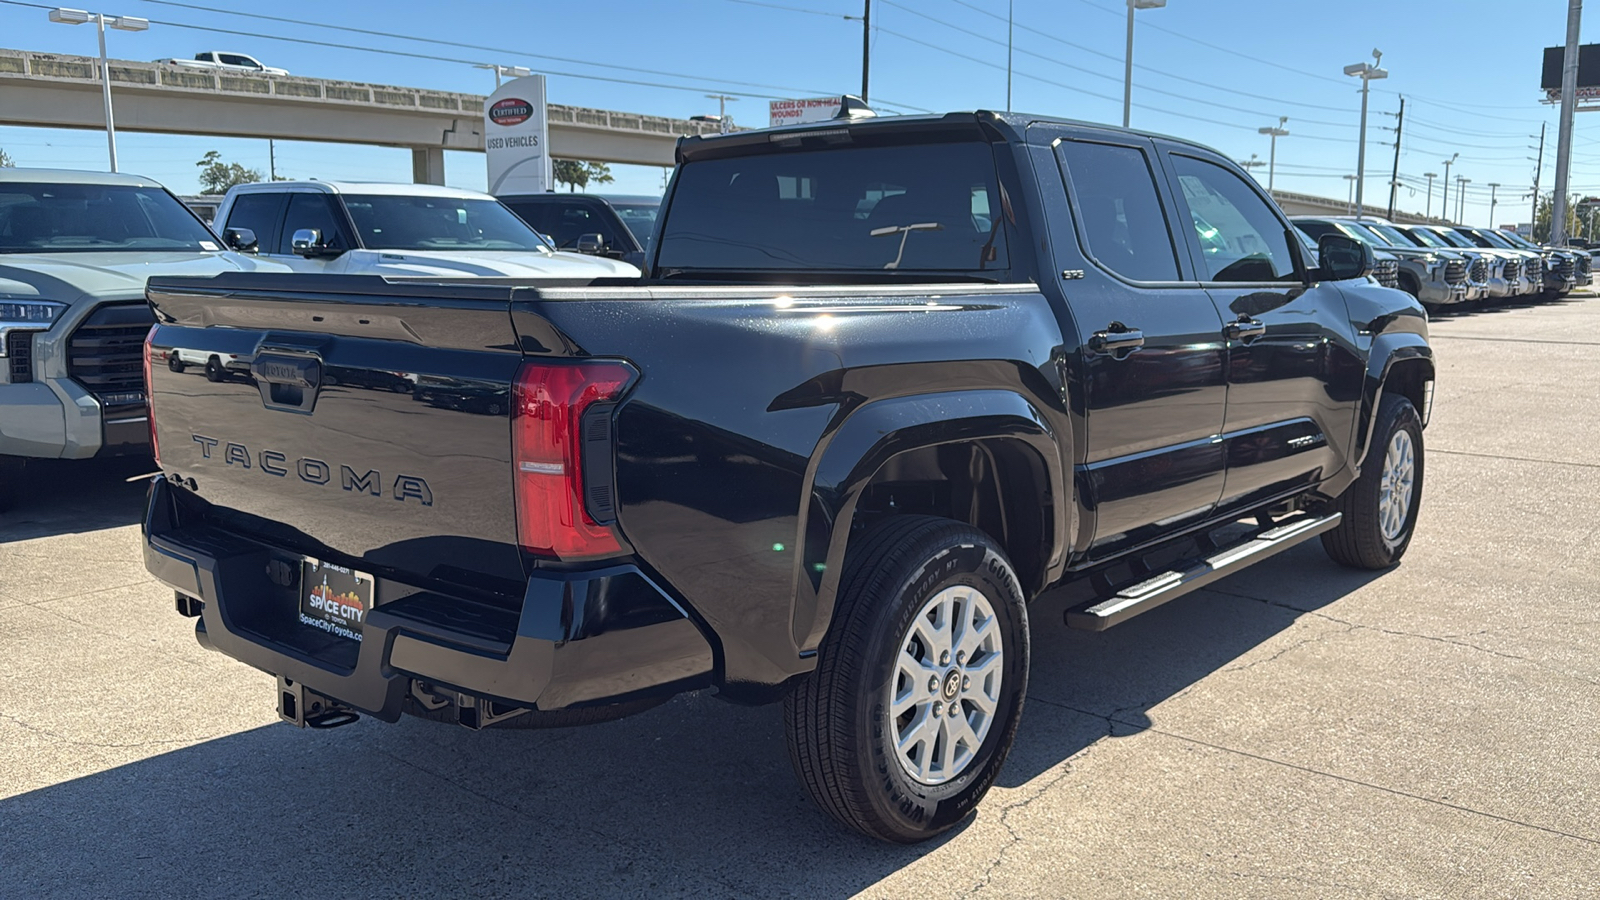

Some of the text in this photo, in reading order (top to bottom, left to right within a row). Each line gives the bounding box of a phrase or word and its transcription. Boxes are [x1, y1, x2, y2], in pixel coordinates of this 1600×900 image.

[771, 97, 842, 110] ULCERS OR NON-HEAL
[771, 109, 803, 119] WOUNDS?
[487, 135, 538, 149] USED VEHICLES
[265, 364, 298, 380] TOYOTA
[191, 433, 434, 507] TACOMA
[309, 594, 364, 623] SPACE CITY
[300, 612, 363, 641] SpaceCityToyota.co
